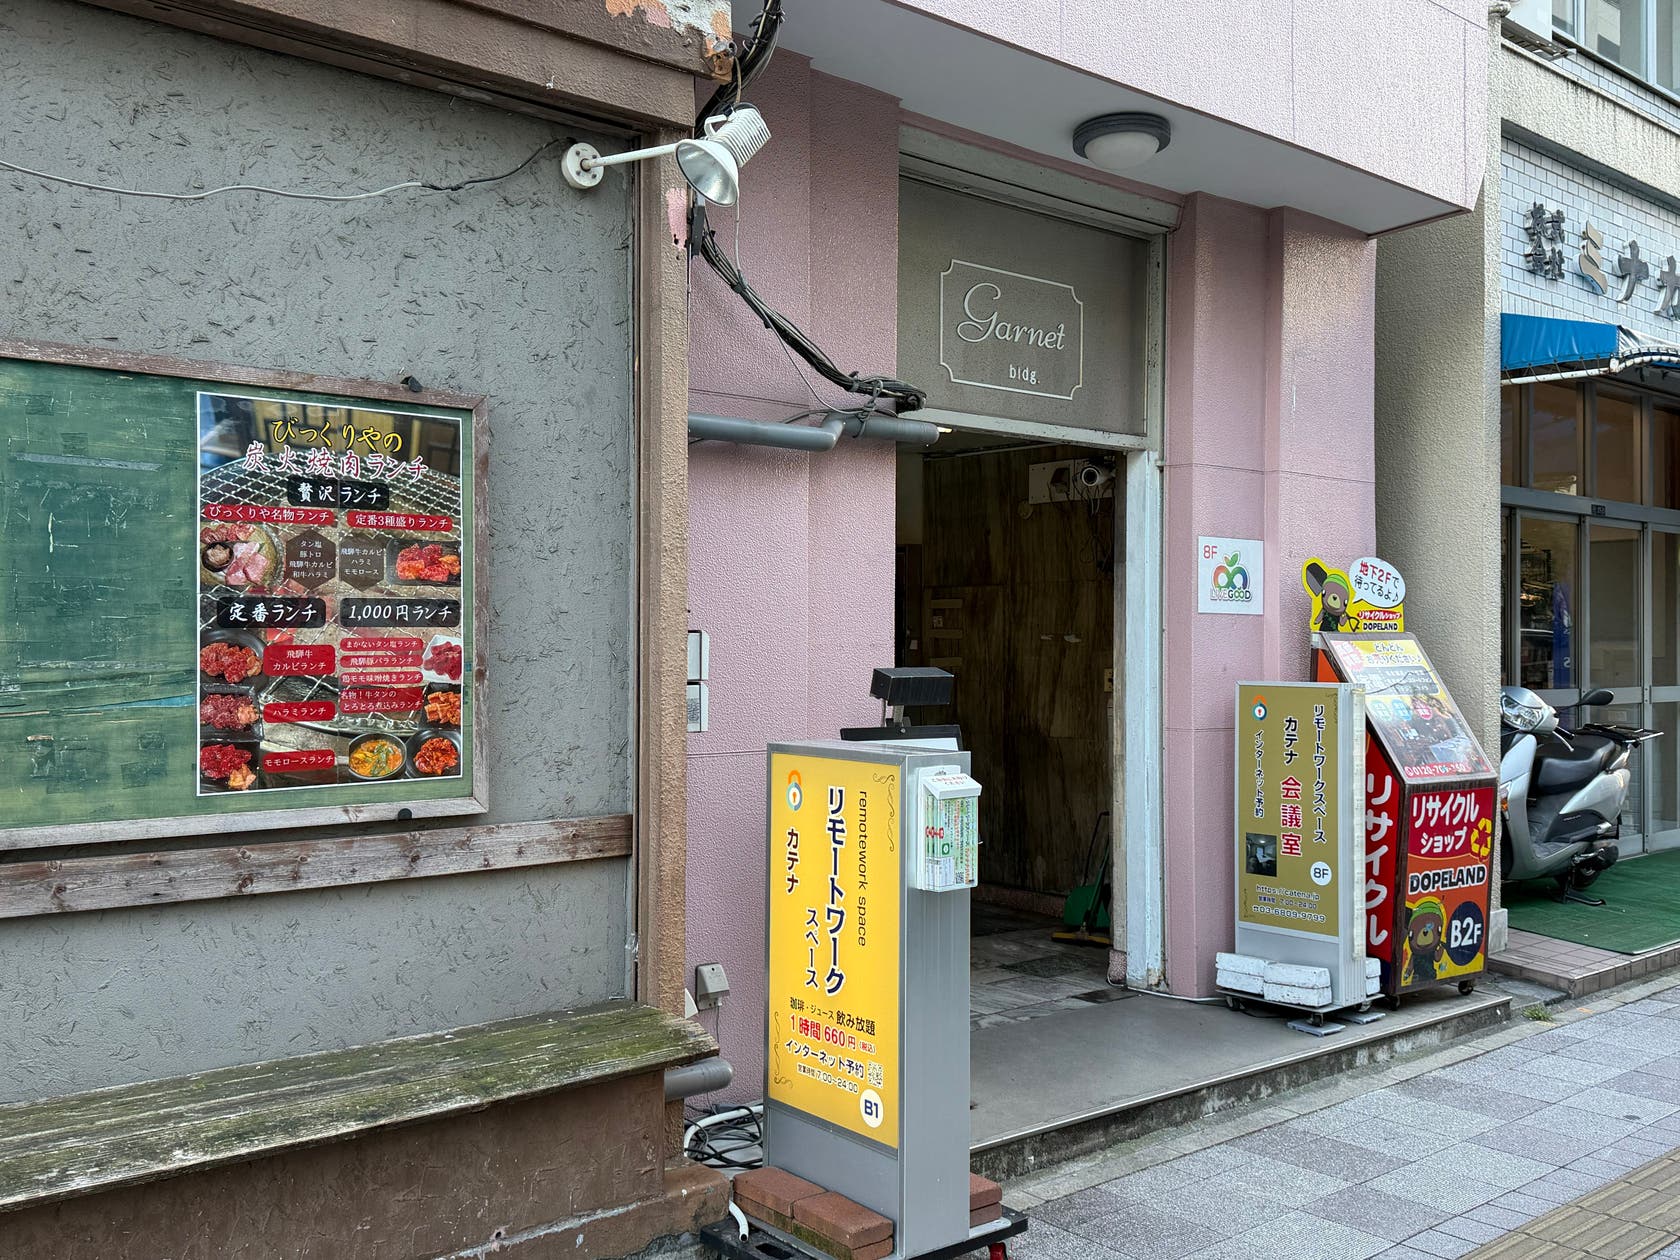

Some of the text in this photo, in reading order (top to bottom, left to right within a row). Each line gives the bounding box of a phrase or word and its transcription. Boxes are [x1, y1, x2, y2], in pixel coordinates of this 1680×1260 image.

[957, 282, 1066, 350] Garnet
[1010, 364, 1041, 385] bldg.
[271, 416, 403, 453] びっくりやの
[242, 440, 428, 483] 炭火焼肉ランチ
[297, 481, 381, 505] 贅沢ランチ
[209, 506, 330, 522] びっくりや名物ランチ
[355, 513, 448, 529] 定番3種盛りランチ
[351, 558, 372, 566] ハラミ
[1203, 545, 1218, 559] 8F
[344, 568, 379, 576] モモロース
[1360, 560, 1400, 590] 地下2Fで
[228, 602, 317, 623] 定番ランチ
[348, 604, 452, 621] 1,000円ランチ
[1363, 622, 1399, 631] DOPELAND
[273, 662, 327, 671] カルビランチ
[287, 649, 313, 659] 飛騨牛
[273, 706, 326, 717] ハラミランチ
[264, 755, 334, 768] モモロースランチ
[1313, 704, 1326, 843] リモートワークスペース
[1280, 716, 1302, 857] カテナ 会議室
[1412, 792, 1480, 829] リサイクル
[1420, 825, 1467, 855] ショップ
[786, 828, 800, 894] カテナ
[857, 790, 869, 947] remotework space
[1313, 866, 1329, 879] 8F
[826, 786, 845, 996] リモートワーク
[1409, 864, 1487, 893] DOPELAND
[1450, 917, 1482, 948] B2F
[805, 908, 820, 988] スペース
[836, 1009, 876, 1036] 飲み放題
[785, 1039, 865, 1079] インターネット予約
[864, 1098, 879, 1119] B1
